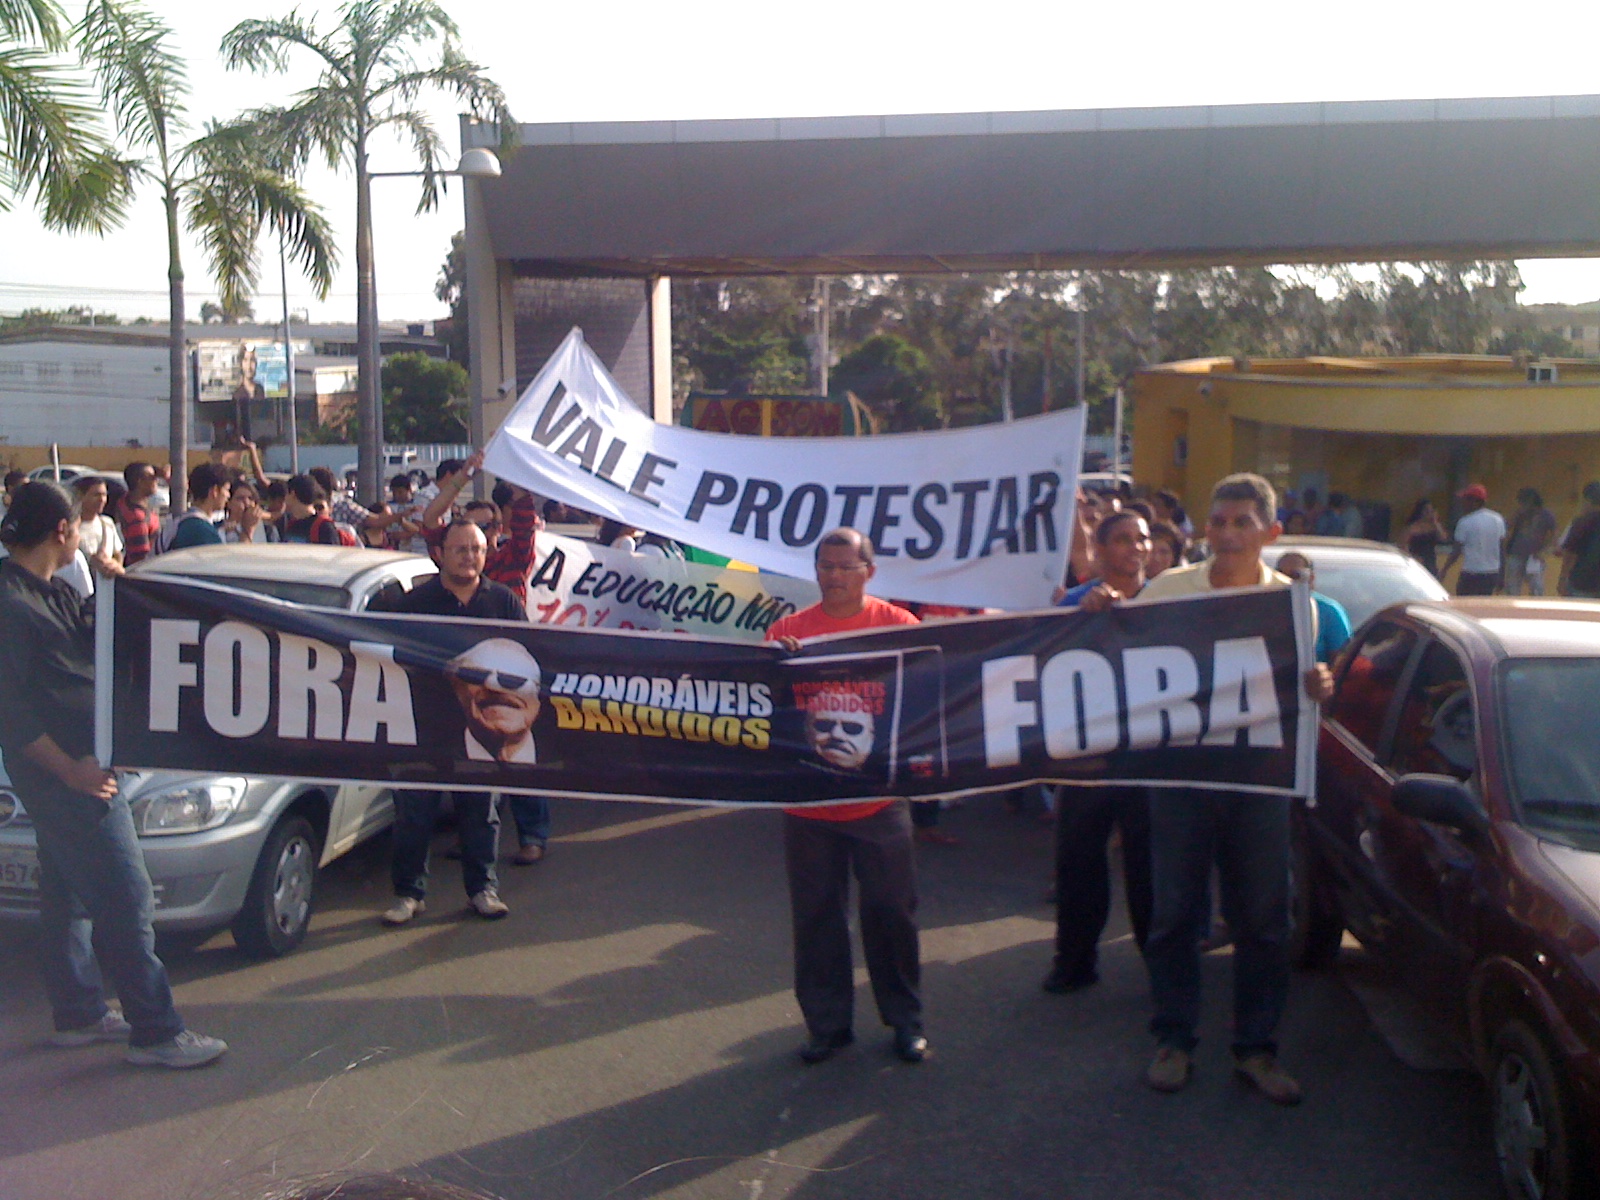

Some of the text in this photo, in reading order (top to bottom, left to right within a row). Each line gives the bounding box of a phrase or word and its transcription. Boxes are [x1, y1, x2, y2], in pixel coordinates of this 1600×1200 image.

[530, 380, 1062, 559] VALE PROTESTAR
[530, 546, 566, 592] A
[572, 562, 735, 624] EDUCAÇÃO
[149, 618, 417, 745] FORA
[550, 674, 773, 717] HONORÁVEIS
[550, 695, 771, 750] BANDIDOS
[982, 636, 1283, 769] FORA
